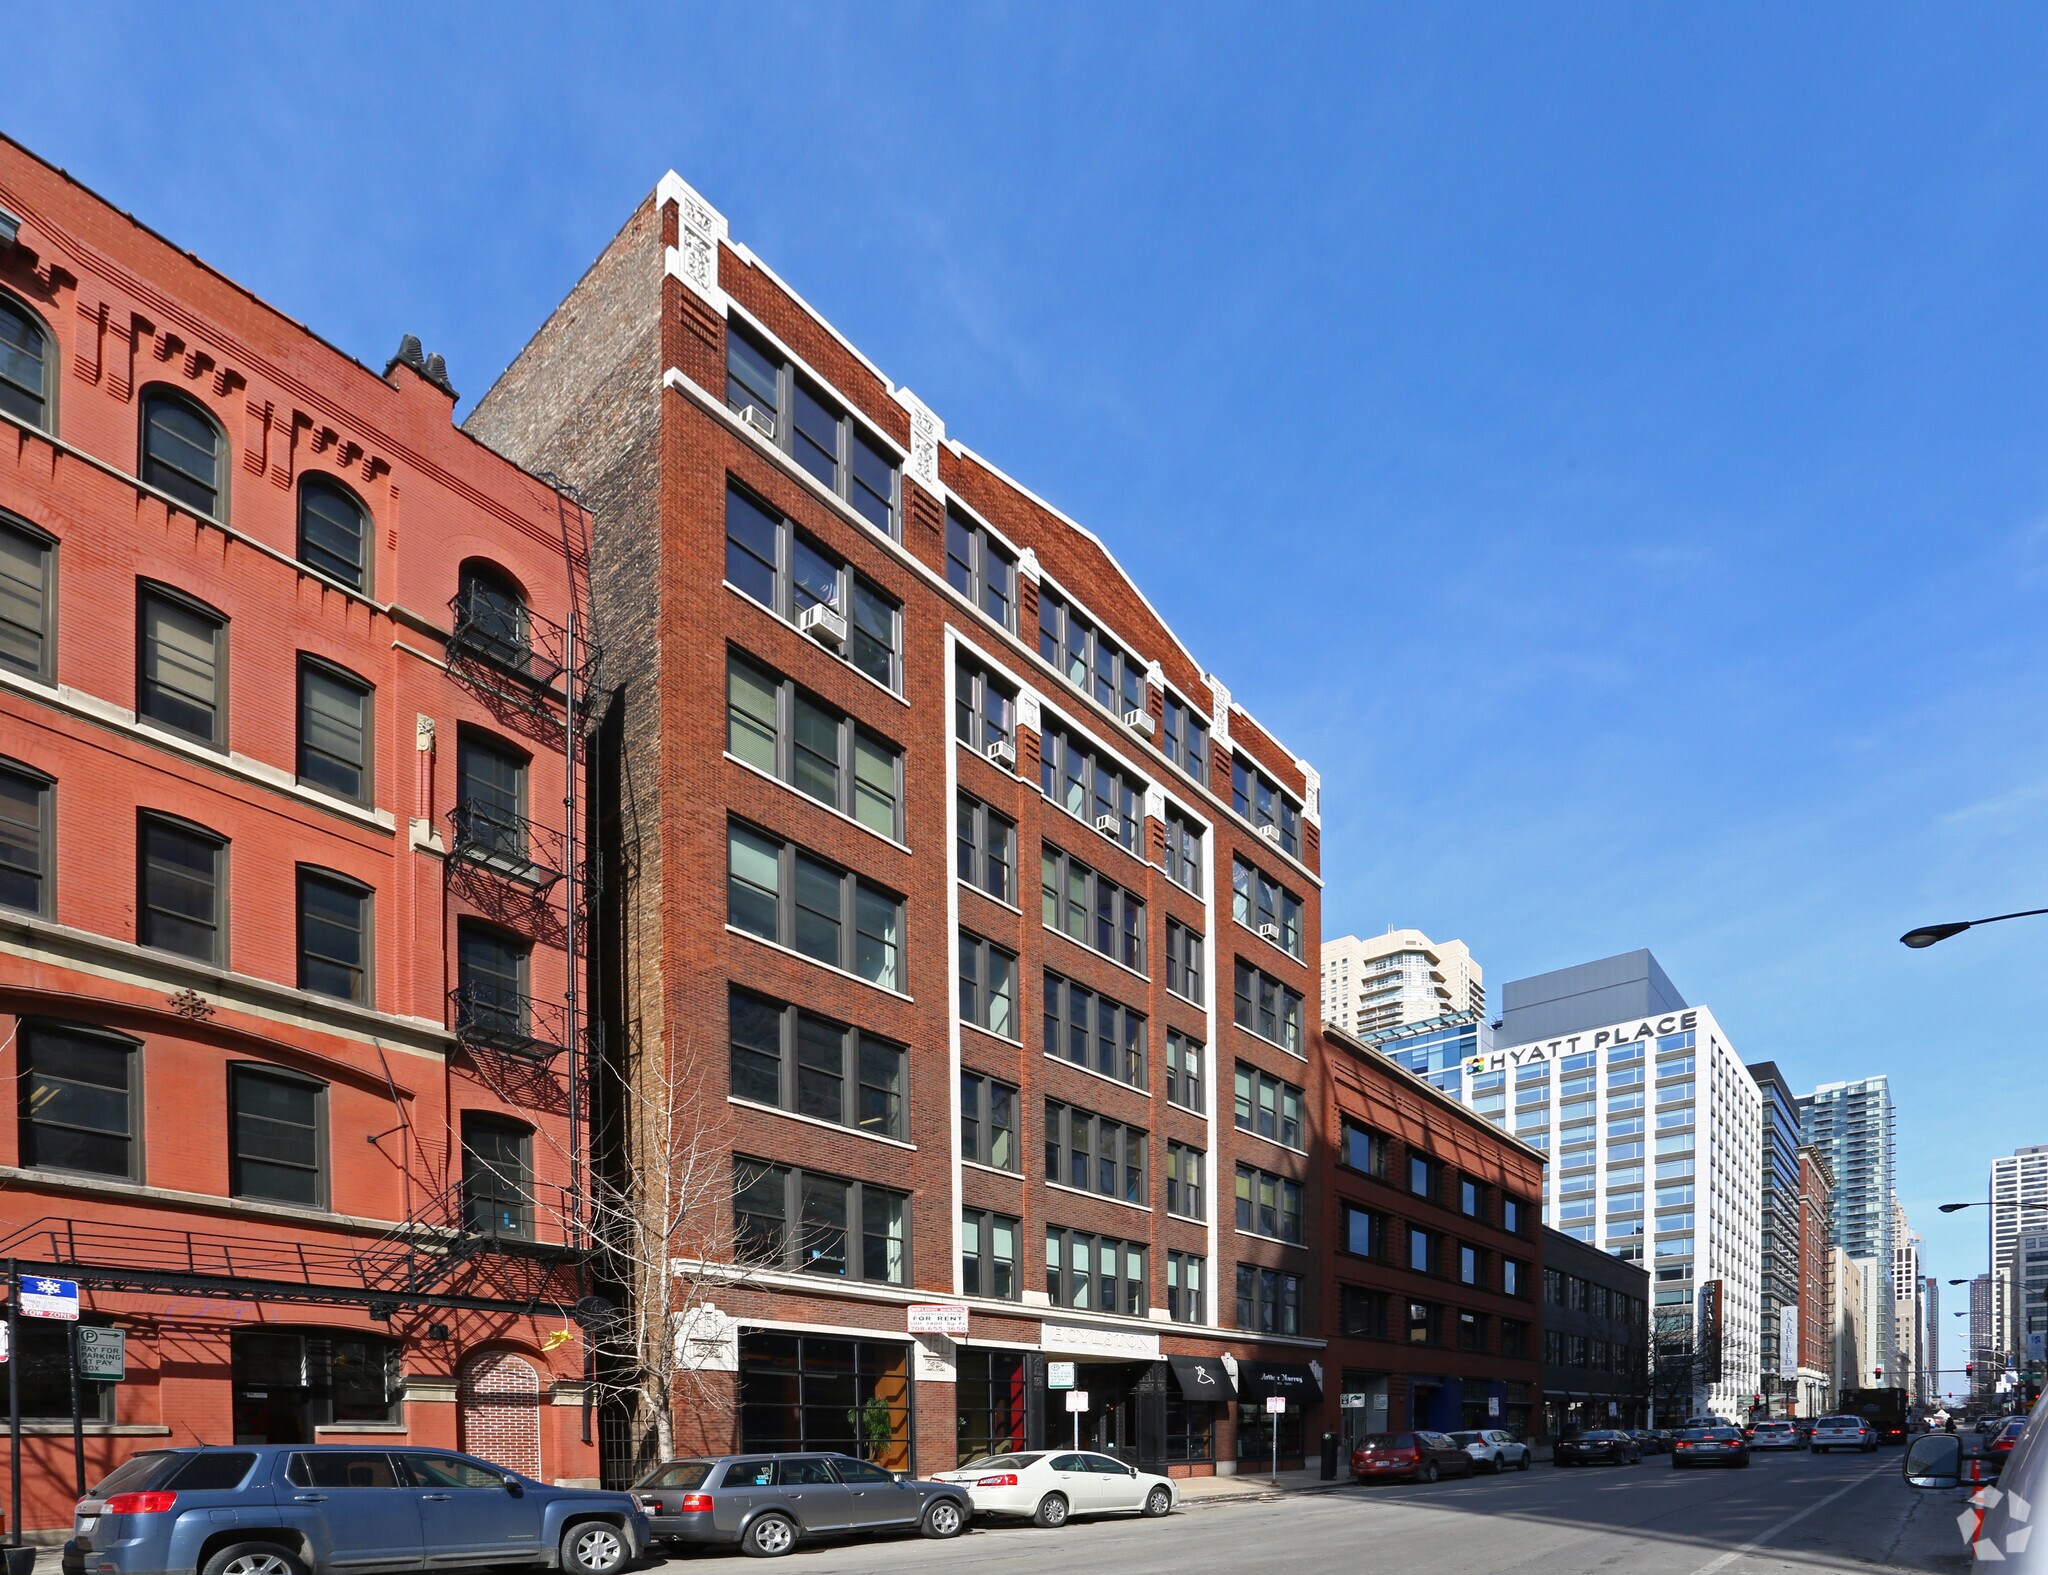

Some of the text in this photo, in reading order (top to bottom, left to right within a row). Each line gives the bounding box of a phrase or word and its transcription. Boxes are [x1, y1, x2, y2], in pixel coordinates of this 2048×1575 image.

[1490, 1011, 1697, 1070] HYATT PLACE
[48, 1311, 72, 1319] ZONE
[1051, 1327, 1151, 1351] BOYLSTON
[1784, 1310, 1794, 1366] FAIRFIELD
[81, 1352, 121, 1361] PARKING
[1261, 1373, 1280, 1381] Arthr
